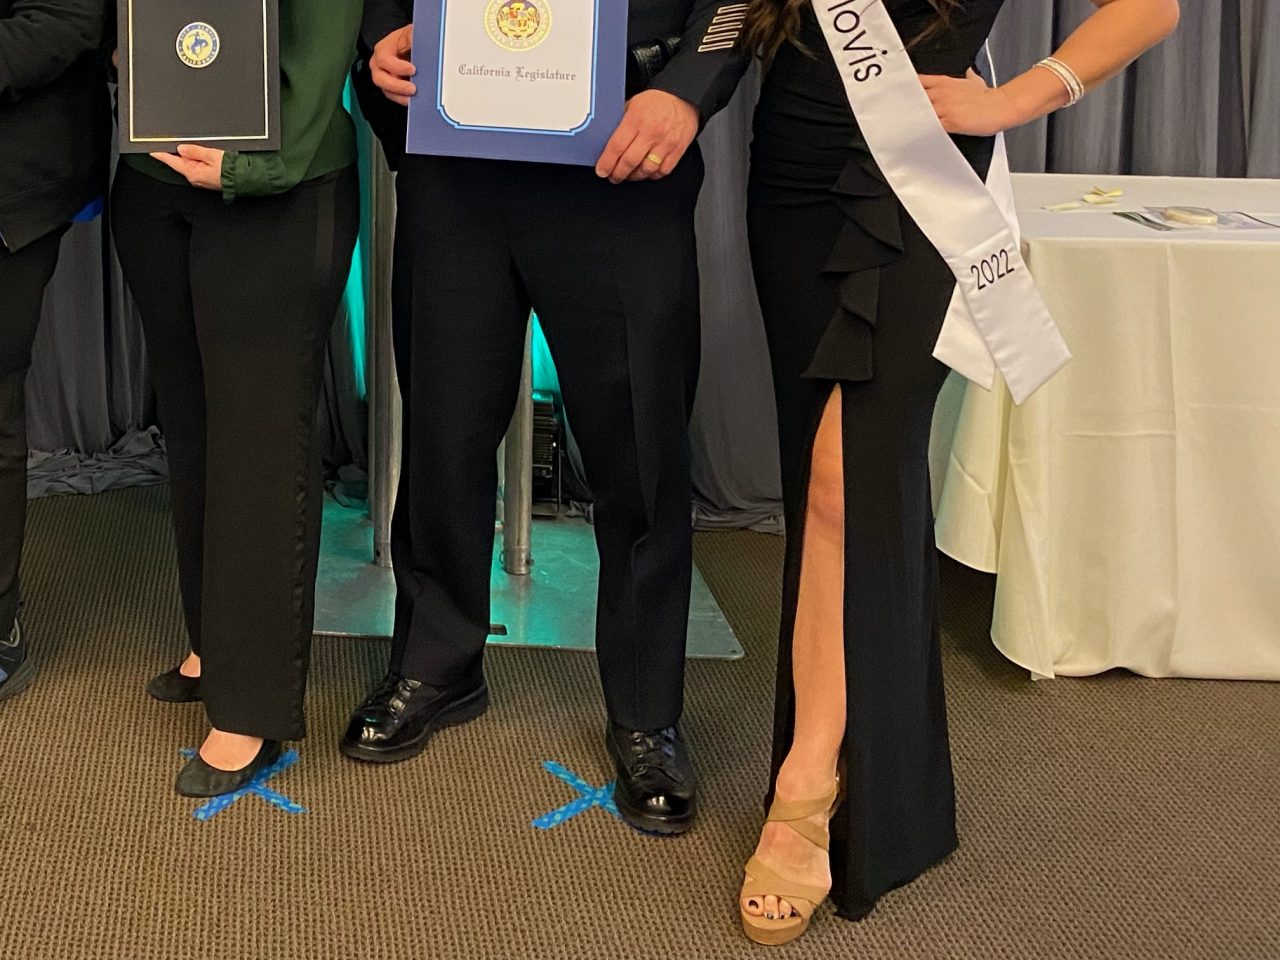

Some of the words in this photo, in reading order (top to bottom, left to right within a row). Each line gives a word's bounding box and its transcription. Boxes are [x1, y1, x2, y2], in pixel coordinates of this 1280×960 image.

[458, 63, 511, 78] California
[514, 66, 577, 82] Legislature
[970, 248, 1015, 291] 2022
